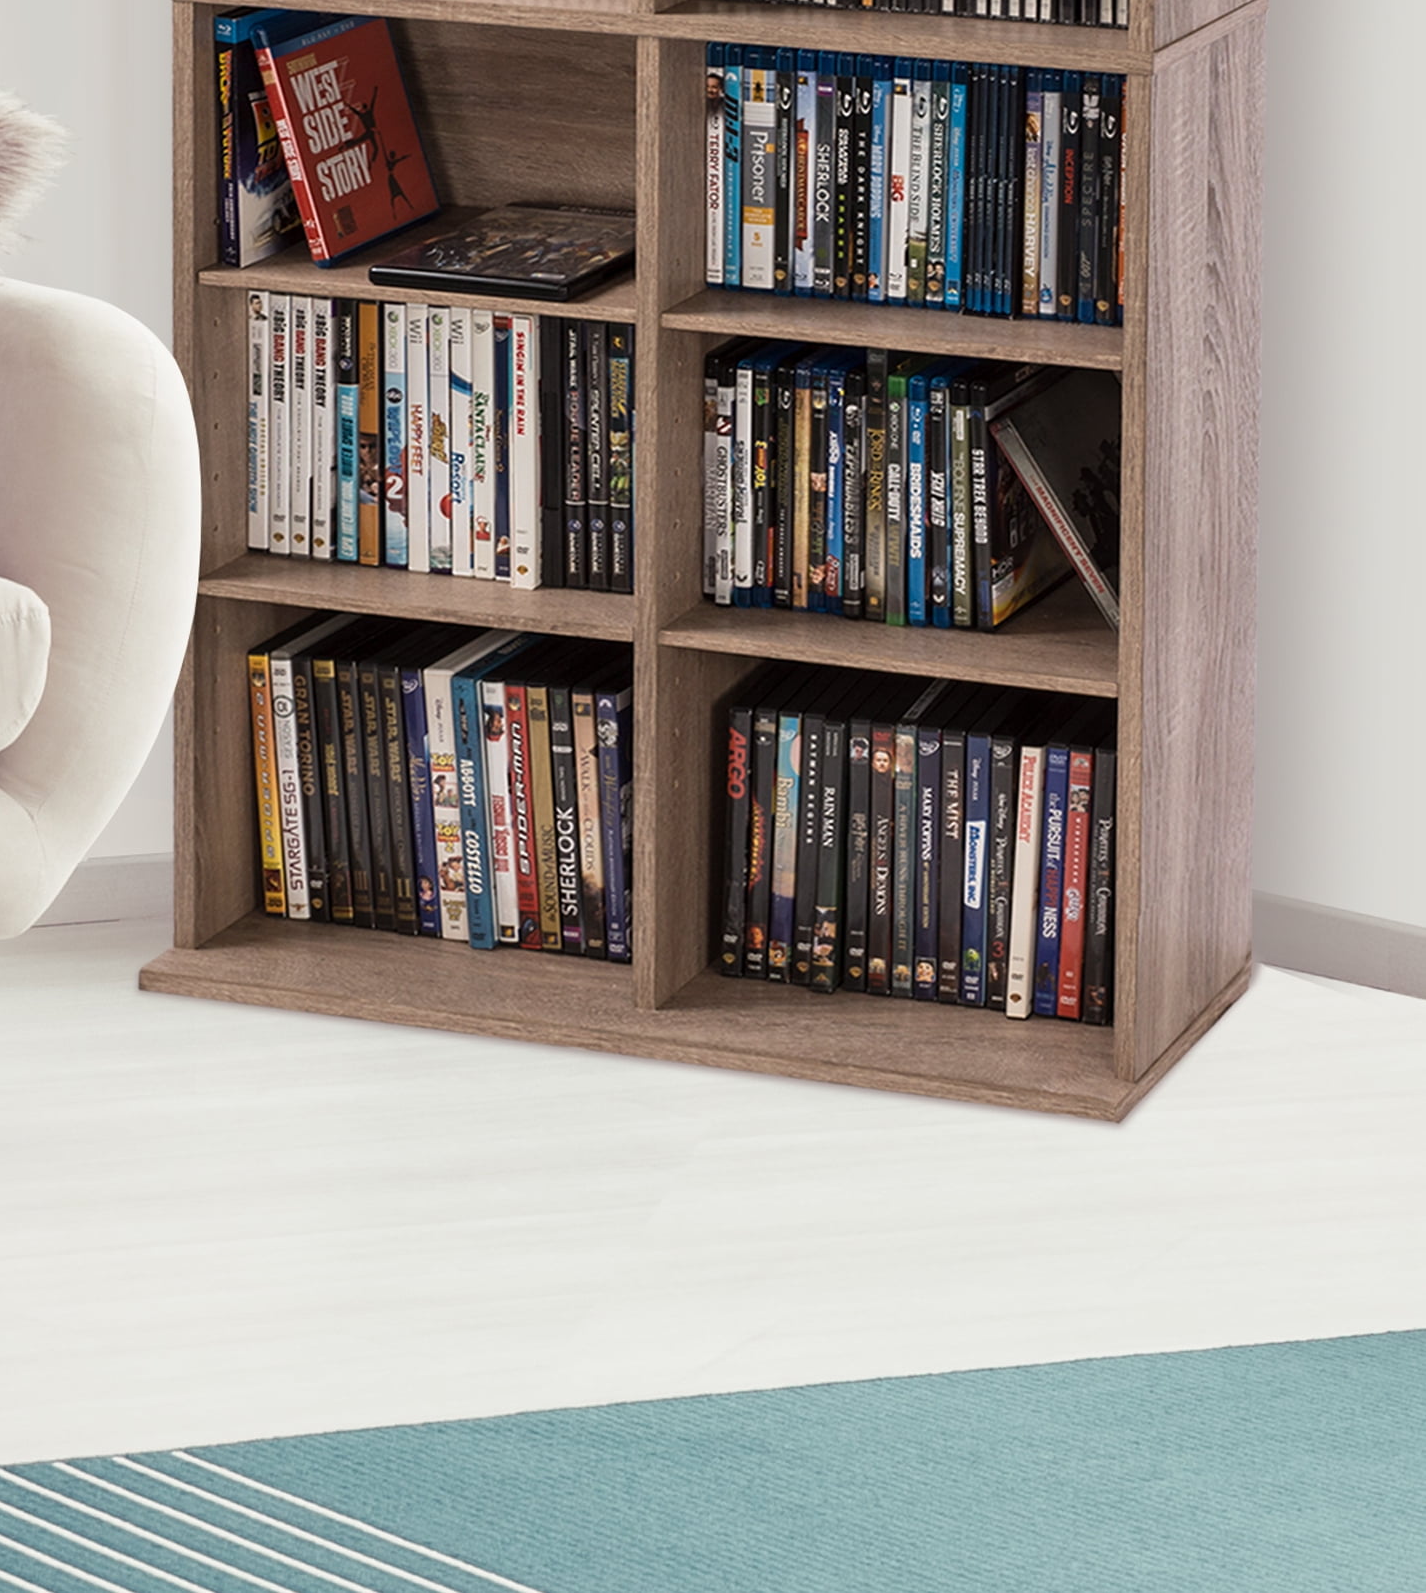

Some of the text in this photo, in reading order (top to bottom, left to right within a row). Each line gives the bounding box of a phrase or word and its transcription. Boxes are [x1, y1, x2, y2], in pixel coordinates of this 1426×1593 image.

[219, 50, 233, 180] BACK FUTURE
[290, 60, 343, 113] WEST
[276, 119, 302, 181] WEST SIDE STORY
[302, 101, 354, 155] SIDE
[858, 132, 866, 157] THE
[315, 143, 372, 202] STORY
[709, 134, 719, 209] TERRY FATOR
[750, 131, 771, 204] Prisoner
[797, 144, 807, 230] CHRISTMAS CAROL
[816, 143, 830, 223] SHERLOCK
[870, 144, 883, 219] MARY POPPINS
[891, 174, 904, 202] BIG
[911, 127, 923, 222] THE BLIND SIDE
[930, 123, 944, 252] SHERLOCK HOLMES
[1042, 159, 1057, 204] Aladdin
[1064, 149, 1075, 204] INCEPTION
[1082, 152, 1094, 227] SPECTRE
[950, 213, 959, 263] UNIVERSITY
[1024, 147, 1038, 276] last chance HARVEY
[296, 330, 305, 390] BANG THEORY
[389, 325, 398, 368] XBOX 360
[409, 319, 422, 344] Wii
[432, 327, 441, 372] XBOX 360
[451, 319, 463, 344] Wii
[274, 334, 285, 403] BANG THEORY
[316, 338, 326, 408] BANG THEORY
[249, 402, 258, 418] THE
[249, 420, 258, 445] ANDY
[474, 392, 486, 483] SANTA CLAUSE
[516, 374, 525, 435] IN THE RAIN
[569, 329, 581, 501] STAR WARS ROGUE LEADER
[890, 414, 898, 449] XBOX ONE
[342, 417, 353, 477] WINTER SPORTS
[386, 407, 404, 499] WIPEOUT 2
[411, 404, 423, 476] HAPPY FEET
[591, 389, 602, 492] SPLINTER CELL
[755, 440, 767, 489] TOY 3
[868, 428, 886, 461] LORD
[249, 487, 258, 513] SHOW
[450, 452, 466, 505] Resort
[717, 446, 727, 537] GHOSTBUSTERS
[845, 444, 859, 533] EXPENDABLES
[868, 470, 886, 511] RINGS
[888, 464, 900, 521] CALL DUTY
[910, 463, 922, 558] BRIDESMAIDS
[931, 470, 945, 527] STAR TREK
[971, 449, 988, 544] STAR TREK BEYOND
[845, 533, 859, 544] 3
[953, 460, 966, 594] BOURNE SUPREMACY
[1035, 485, 1105, 594] MAGNIFICENT SEVEN
[284, 720, 293, 759] SEASON
[294, 675, 315, 796] GRAN TORINO
[341, 690, 354, 732] STAR
[364, 691, 381, 777] STAR WARS
[385, 697, 402, 783] STAR WARS
[258, 714, 274, 858] SPIDER-MAN
[345, 733, 358, 775] WARS
[460, 759, 476, 807] ABBOTT
[727, 727, 747, 799] ARGO
[511, 722, 530, 875] SPIDER-MAN
[580, 754, 595, 871] WALK CLOUDS
[776, 776, 794, 828] Bambi
[806, 734, 817, 845] BATMAN BEGINS
[822, 787, 836, 847] RAIN MAN
[921, 787, 932, 861] MARY POPPINS
[946, 769, 960, 839] THE MIST
[1019, 755, 1037, 843] POLICE ACADEMY
[281, 769, 304, 890] STARGATE SG-1
[465, 830, 483, 895] COSTELLO
[556, 806, 578, 916] SHERLOCK
[996, 836, 1008, 875] PIRATES
[1072, 817, 1082, 884] WIDESCREEN
[1098, 816, 1113, 861] PIRATES
[541, 825, 557, 913] SOUND MUSIC
[875, 815, 891, 916] ANGELS DEMONS
[898, 813, 907, 950] RIVER RUNS THROUGH IT
[967, 884, 978, 903] INC.
[1042, 793, 1062, 938] the PURSUIT of HAPPYNESS
